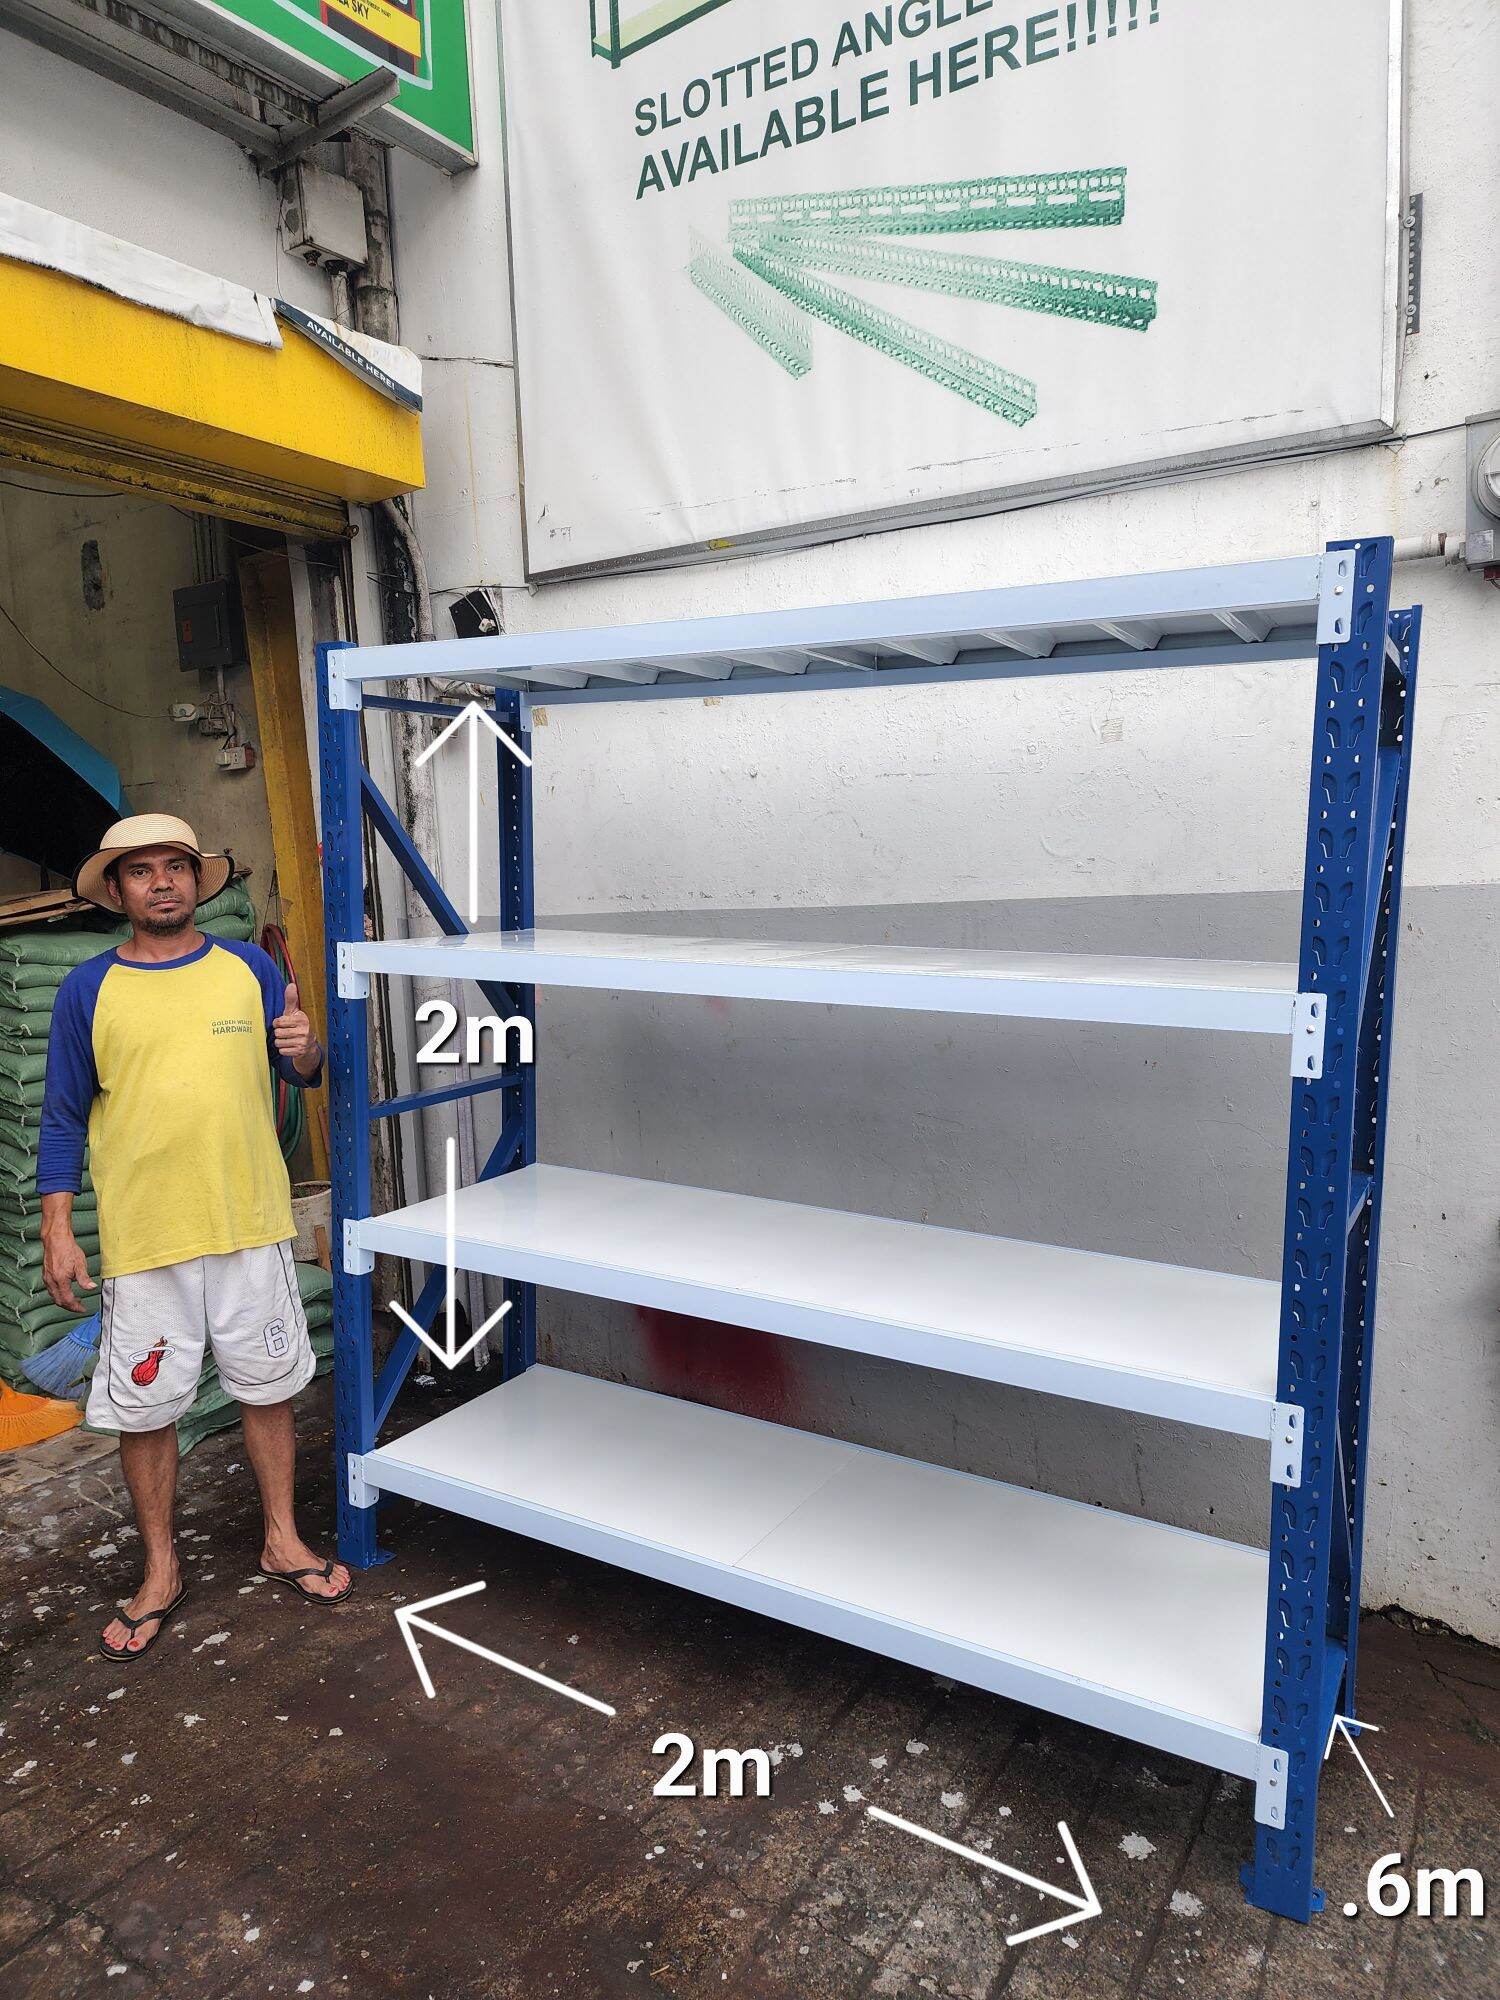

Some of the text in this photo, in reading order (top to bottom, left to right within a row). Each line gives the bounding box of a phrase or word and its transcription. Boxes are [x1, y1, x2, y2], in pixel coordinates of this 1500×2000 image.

[351, 0, 369, 20] SKY
[635, 38, 819, 137] SLOTTED
[636, 0, 1159, 200] AVAILABLE HERE!!!!!
[307, 320, 395, 391] AVAILABLE HERE!
[211, 1019, 236, 1027] GOLDEN
[212, 1025, 253, 1035] HARDWARE
[263, 1317, 289, 1358] 6
